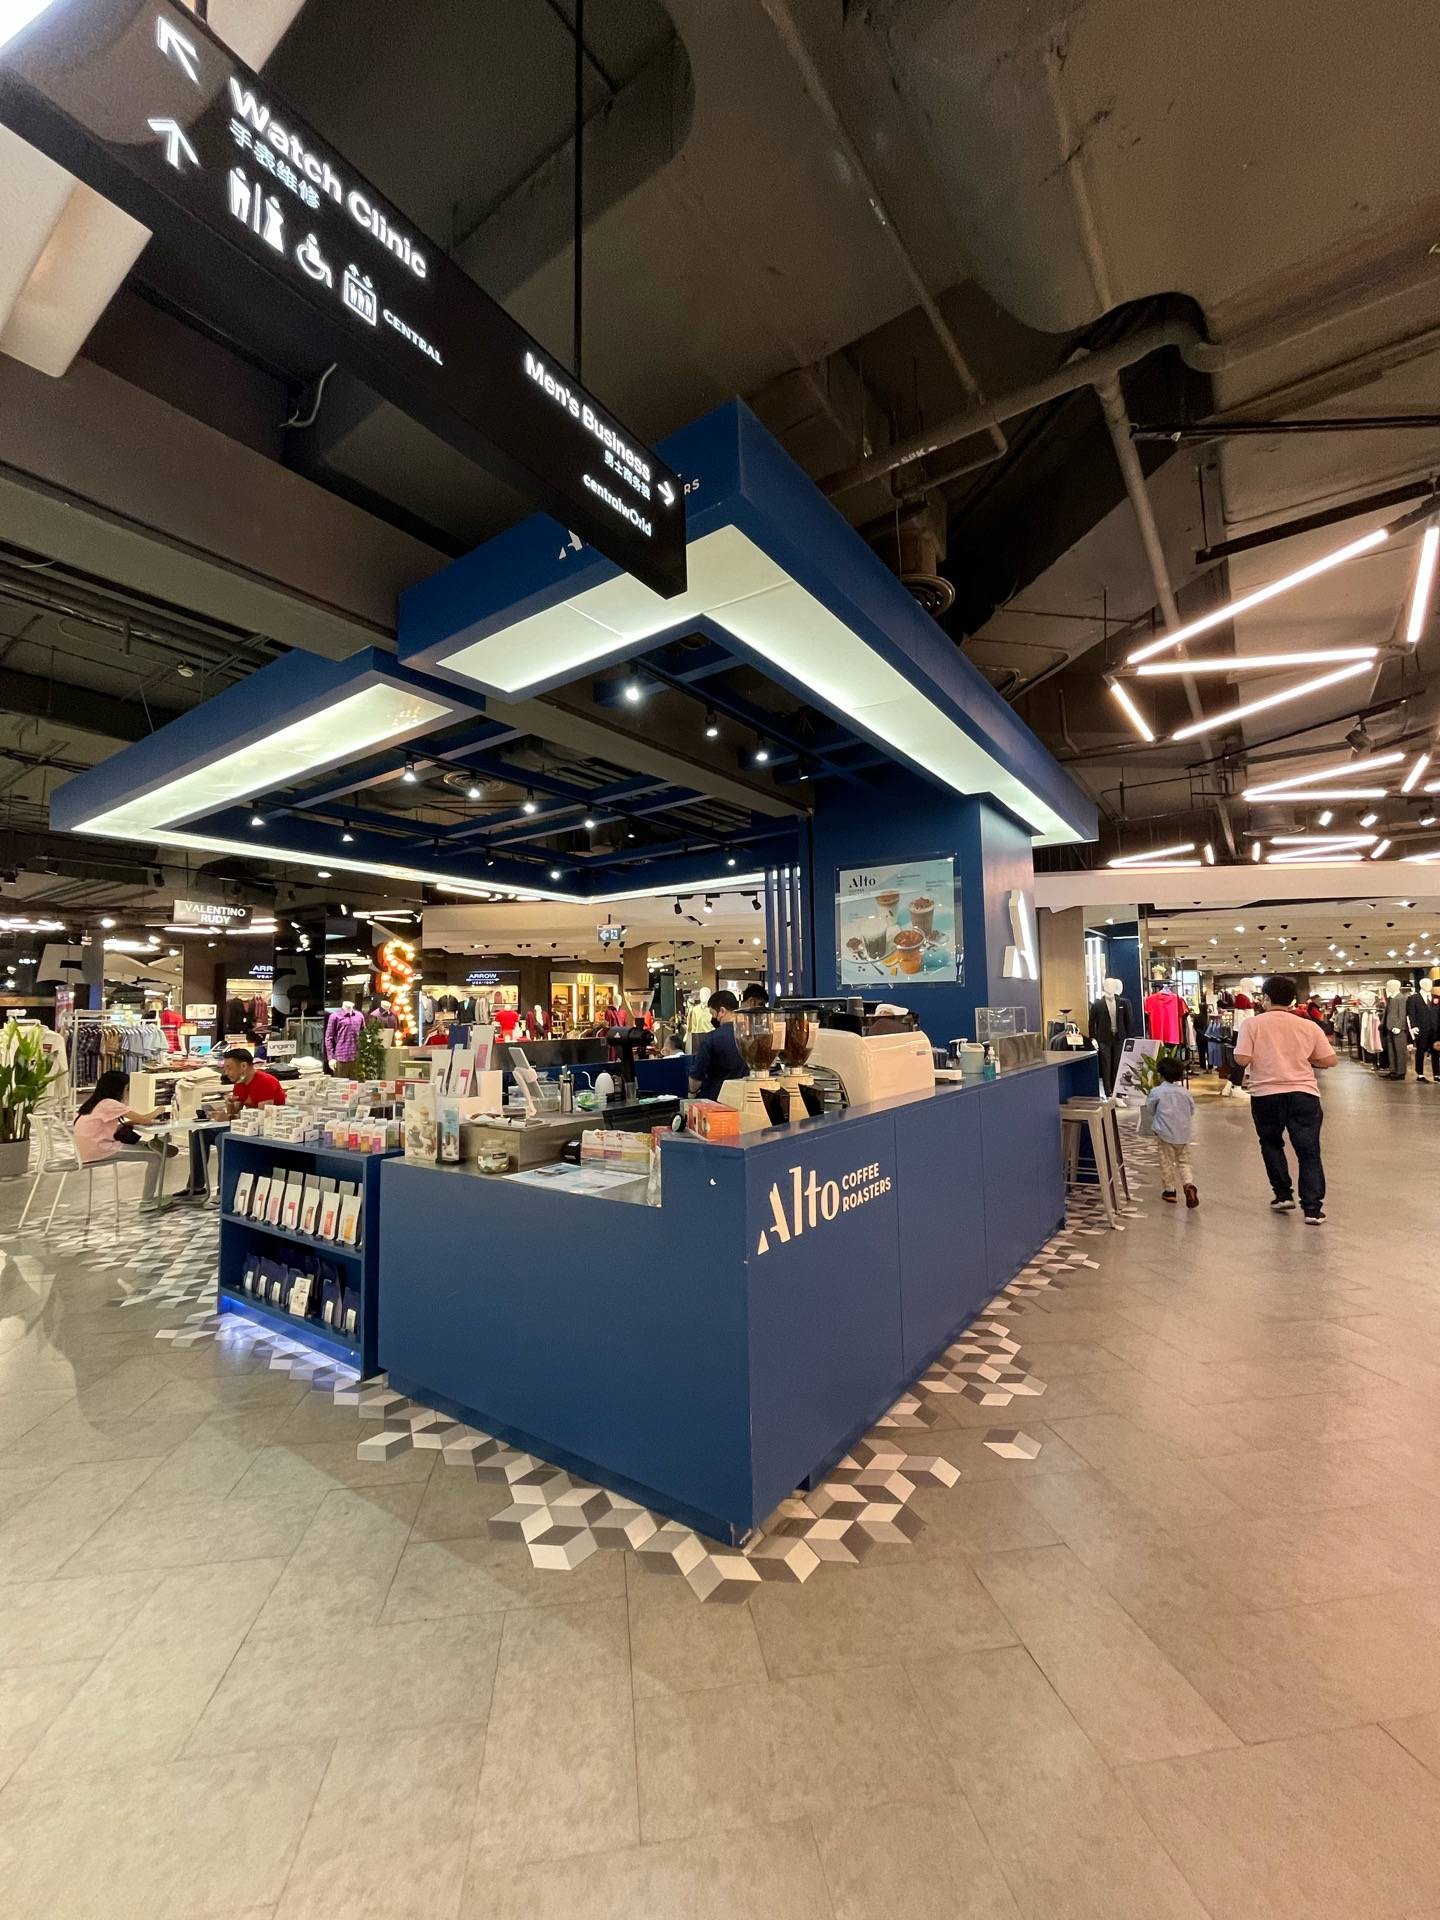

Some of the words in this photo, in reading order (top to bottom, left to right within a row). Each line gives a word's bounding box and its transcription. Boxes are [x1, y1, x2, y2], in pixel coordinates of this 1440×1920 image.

[229, 117, 321, 209] 手表维修
[229, 76, 342, 205] Watch
[348, 191, 427, 279] Clinic
[382, 308, 444, 367] CENTRAL
[525, 351, 580, 419] Men's
[581, 403, 651, 483] Business
[184, 903, 246, 917] VALENTINO
[849, 875, 876, 888] Alto
[200, 915, 231, 925] RUDY
[757, 1165, 840, 1256] Alto
[842, 1162, 880, 1191] COFFEE
[842, 1176, 892, 1213] ROASTERS
